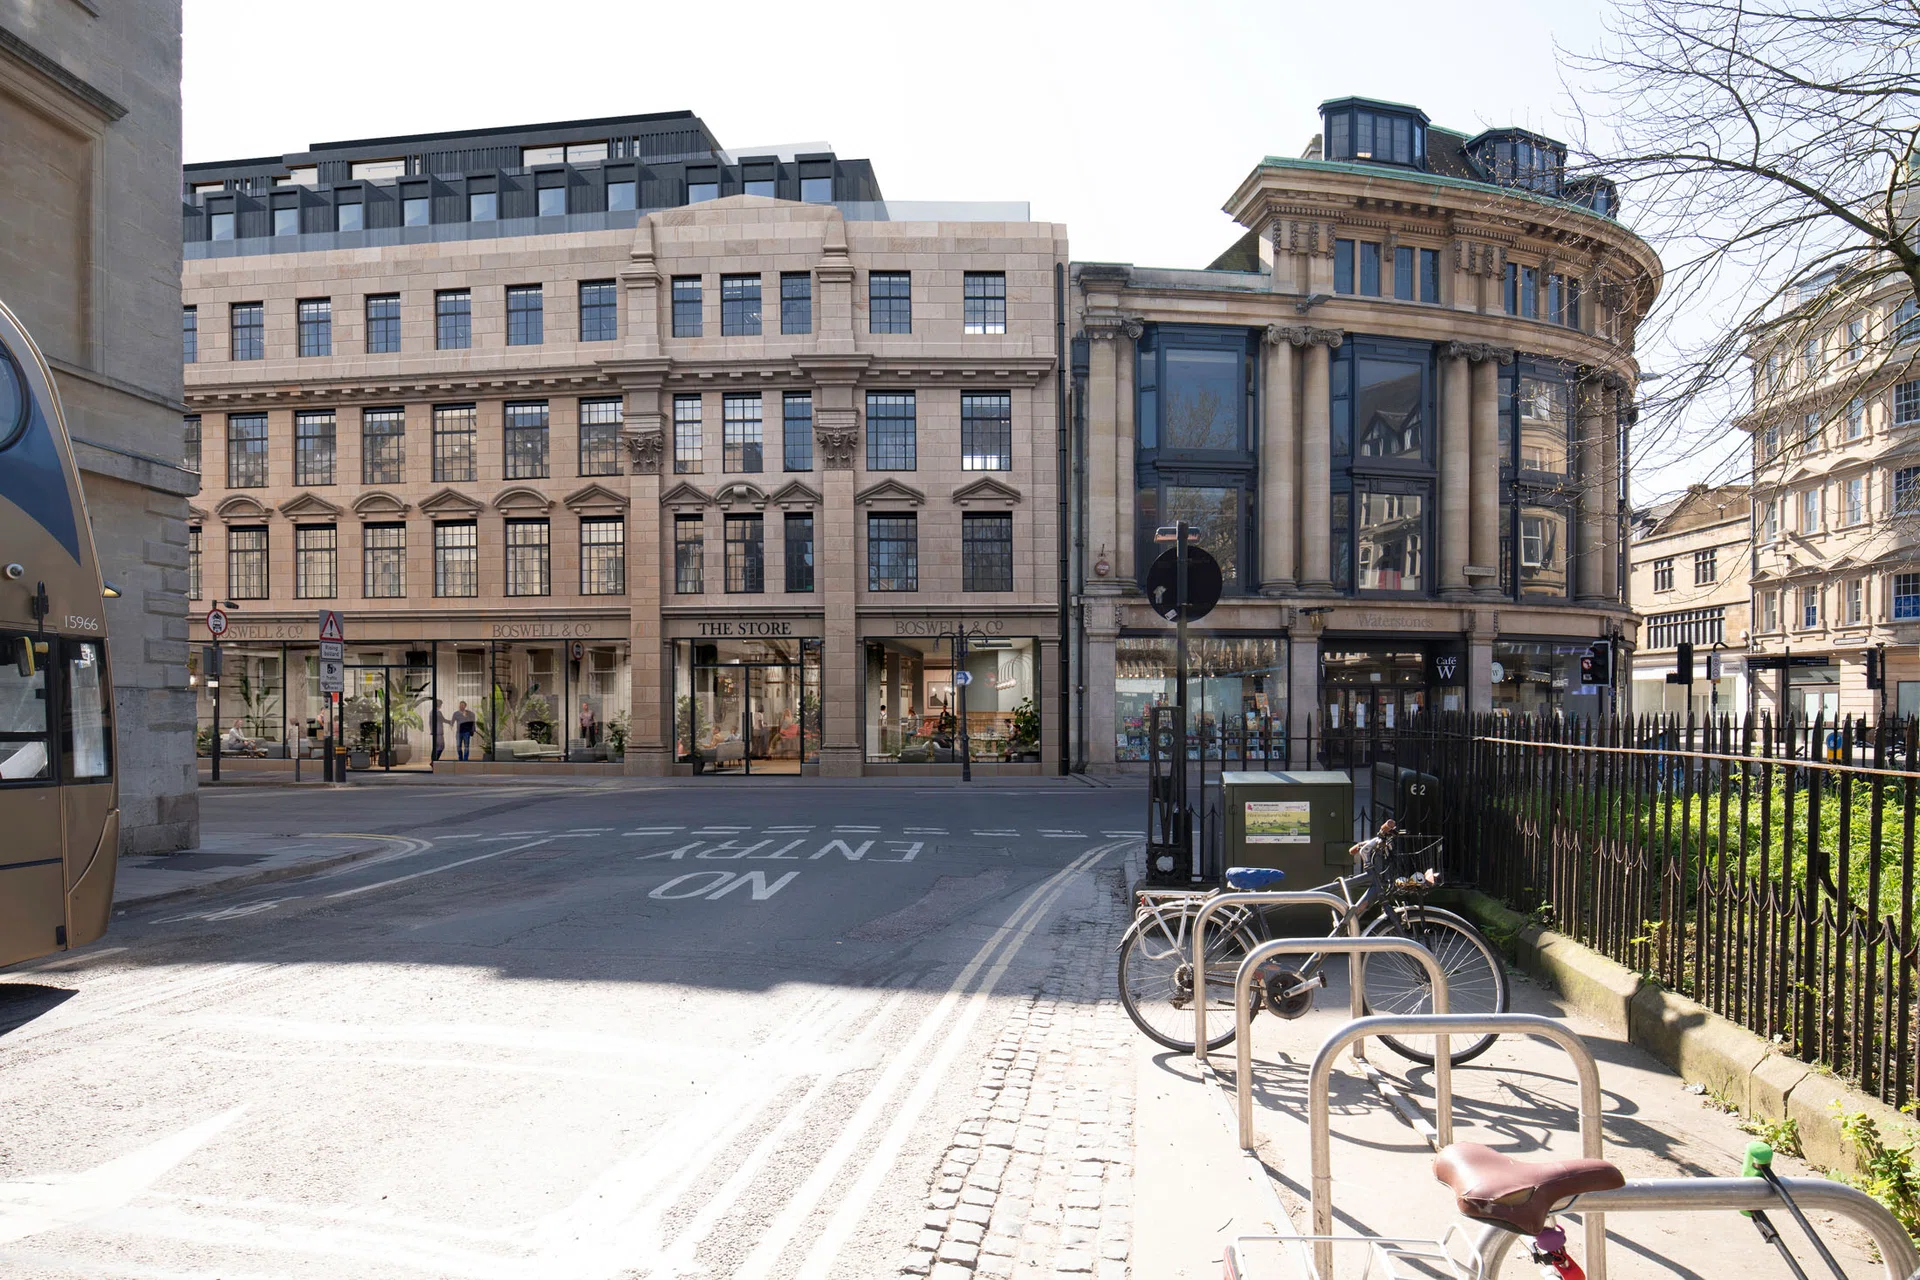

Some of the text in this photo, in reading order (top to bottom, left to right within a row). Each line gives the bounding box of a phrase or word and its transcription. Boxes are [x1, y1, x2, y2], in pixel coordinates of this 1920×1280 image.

[64, 615, 99, 631] 15966
[972, 620, 982, 634] &
[1356, 613, 1433, 628] Waterstones
[216, 625, 273, 639] OSWELL
[275, 626, 284, 638] &
[492, 624, 558, 638] BOSWELL
[561, 623, 571, 637] &
[698, 622, 792, 635] THE STORE
[1436, 656, 1457, 665] Café
[1436, 665, 1456, 680] W
[634, 838, 925, 863] ENTRY
[647, 870, 801, 901] NO
